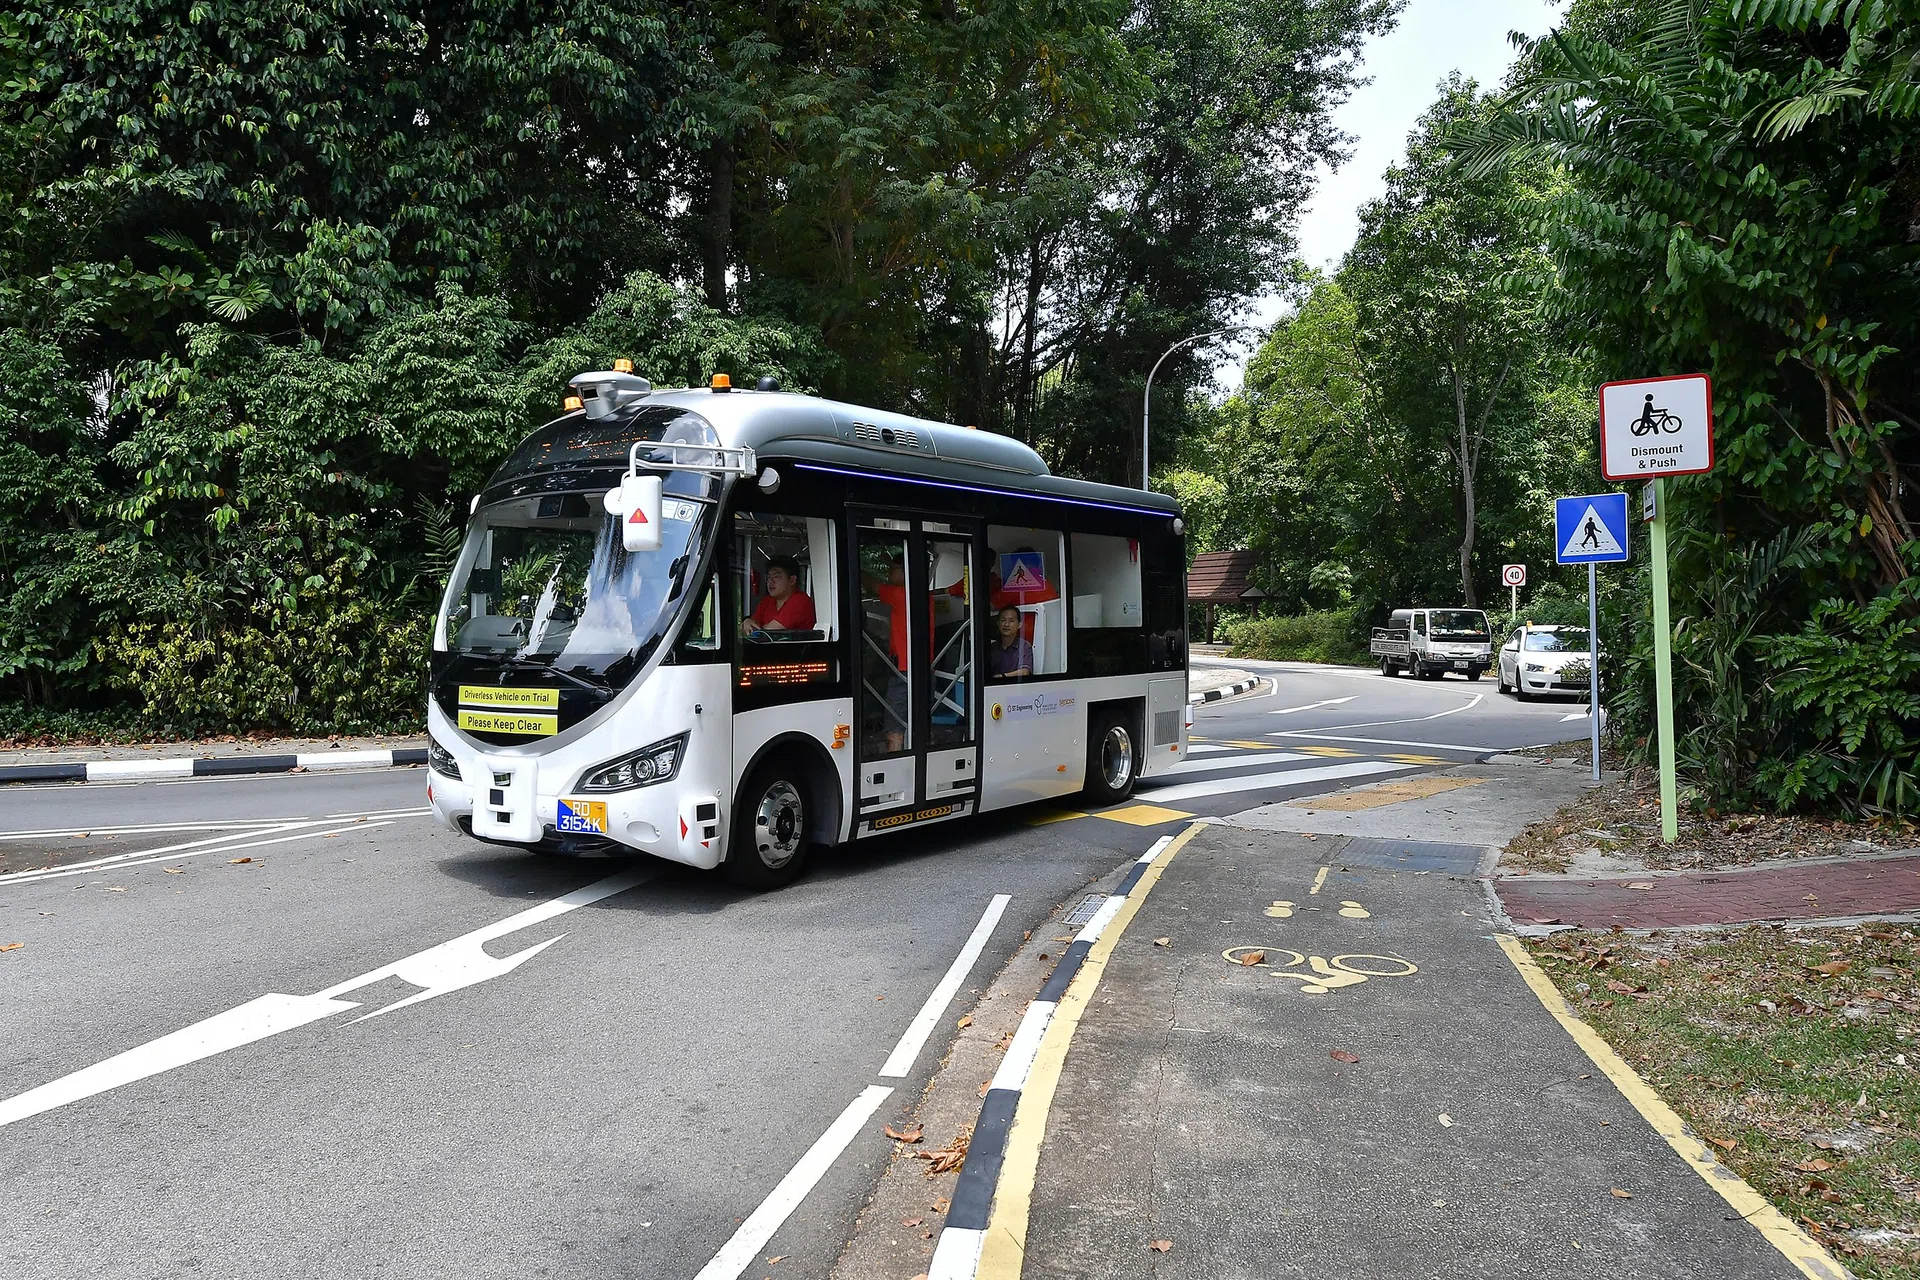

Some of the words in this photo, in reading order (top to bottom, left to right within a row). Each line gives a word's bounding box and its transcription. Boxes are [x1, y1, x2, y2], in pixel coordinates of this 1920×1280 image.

[1631, 444, 1683, 457] Dismount
[1638, 460, 1646, 469] &
[1650, 458, 1677, 468] Push
[1510, 571, 1519, 579] 40
[464, 690, 493, 700] Driverless
[495, 692, 519, 701] Vehicle
[521, 694, 530, 702] on
[532, 693, 550, 702] Trial
[467, 716, 492, 729] Please
[493, 718, 515, 732] Keep
[517, 720, 542, 731] Clear
[572, 801, 590, 817] RD
[560, 815, 602, 832] 3154K
